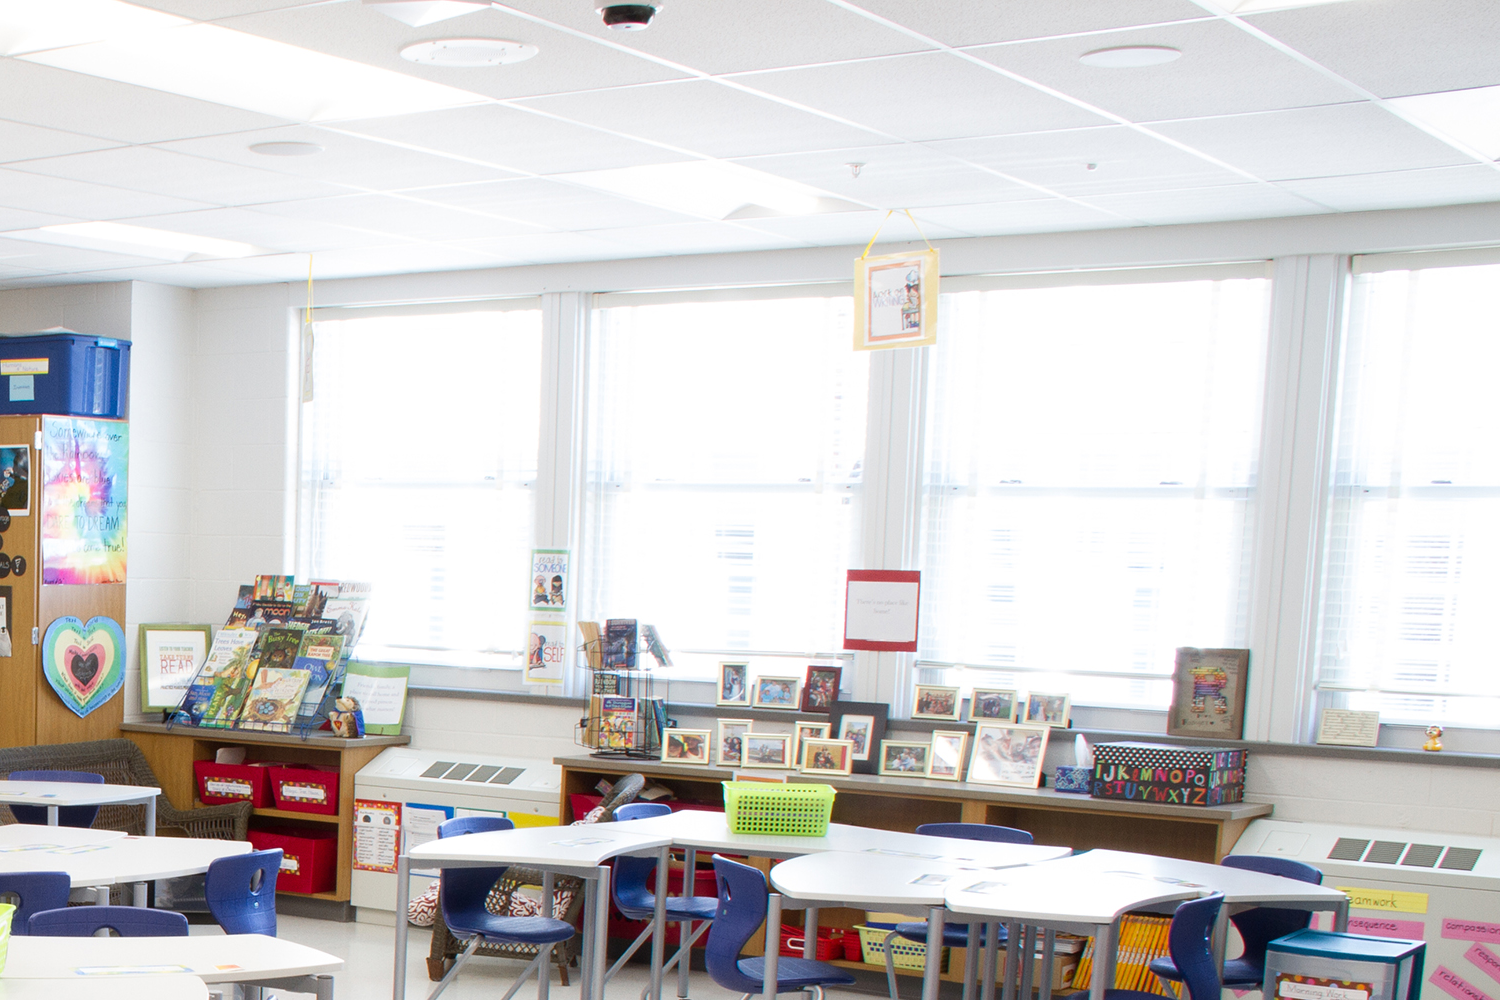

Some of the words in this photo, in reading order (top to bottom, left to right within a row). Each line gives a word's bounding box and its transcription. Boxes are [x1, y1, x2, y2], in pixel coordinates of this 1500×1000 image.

[74, 515, 85, 530] TO
[88, 515, 120, 531] DREAM
[103, 536, 125, 553] true!
[539, 556, 556, 564] read
[534, 563, 566, 573] SOMEONE
[268, 635, 285, 643] Busy
[287, 632, 299, 645] Tree
[543, 646, 564, 662] SELF
[160, 659, 193, 674] READ
[304, 663, 322, 672] OWL
[1347, 919, 1398, 931] nsequence
[1286, 984, 1323, 1000] Morning
[1326, 989, 1348, 998] Work
